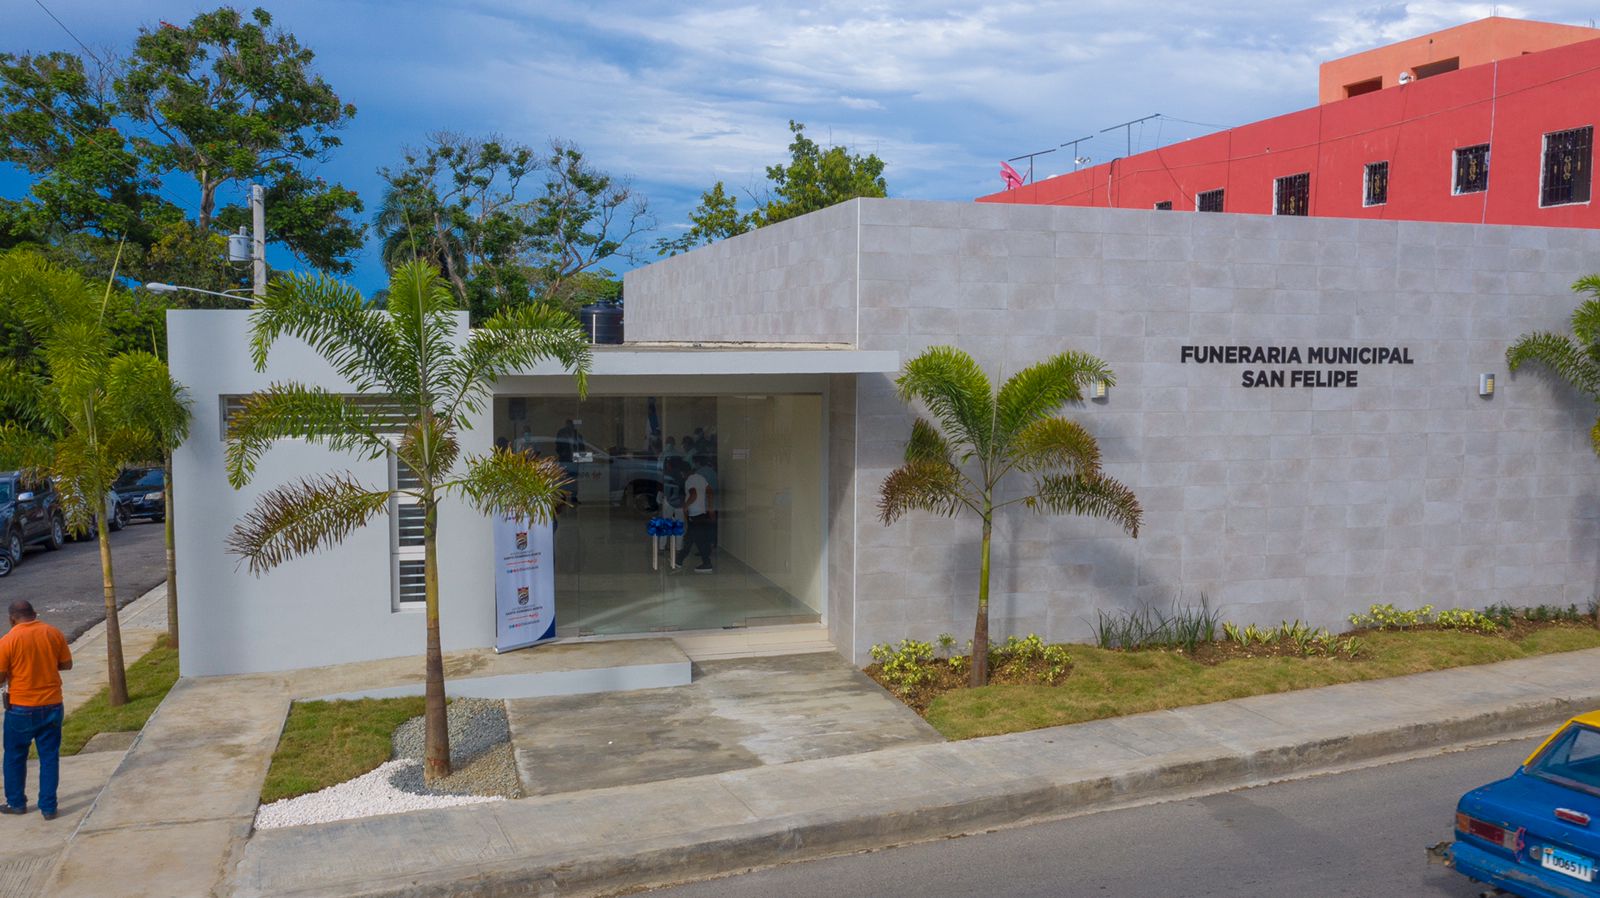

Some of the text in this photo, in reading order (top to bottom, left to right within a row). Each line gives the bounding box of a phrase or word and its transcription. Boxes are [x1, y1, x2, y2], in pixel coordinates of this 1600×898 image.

[1180, 346, 1414, 365] FUNERARIA MUNICIPAL
[1241, 370, 1358, 388] SAN FELIPE
